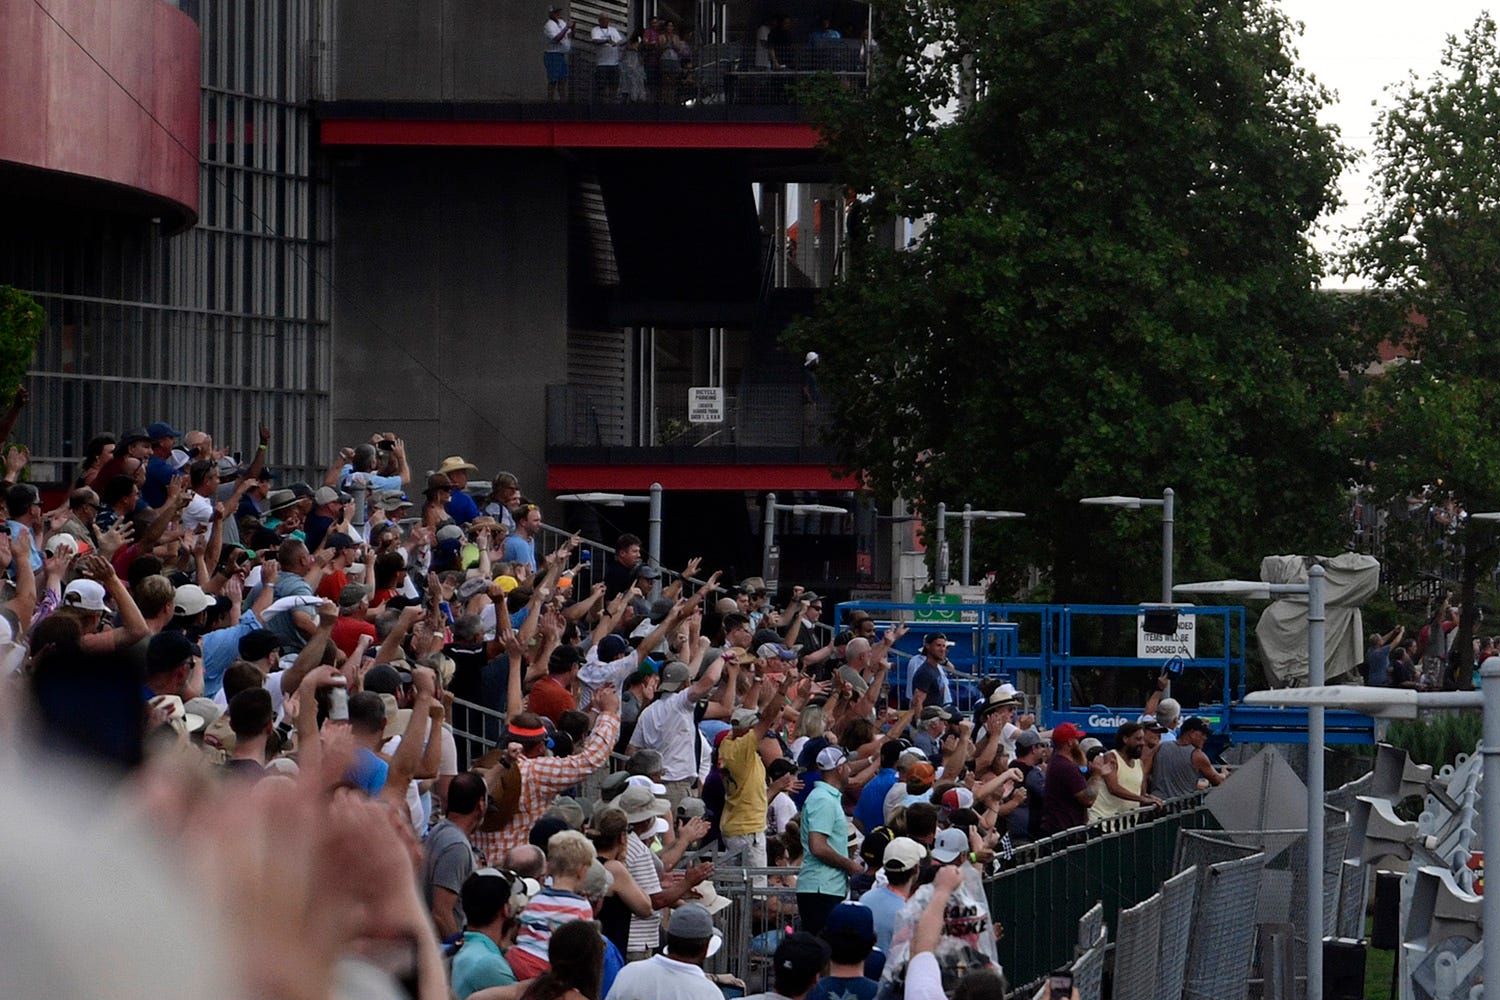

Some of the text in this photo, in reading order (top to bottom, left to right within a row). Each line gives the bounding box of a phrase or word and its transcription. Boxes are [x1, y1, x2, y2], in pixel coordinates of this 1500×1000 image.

[1143, 633, 1163, 642] ITEMS
[1180, 633, 1190, 642] BE
[1145, 645, 1176, 654] DISPOSED
[1088, 714, 1128, 727] Genie
